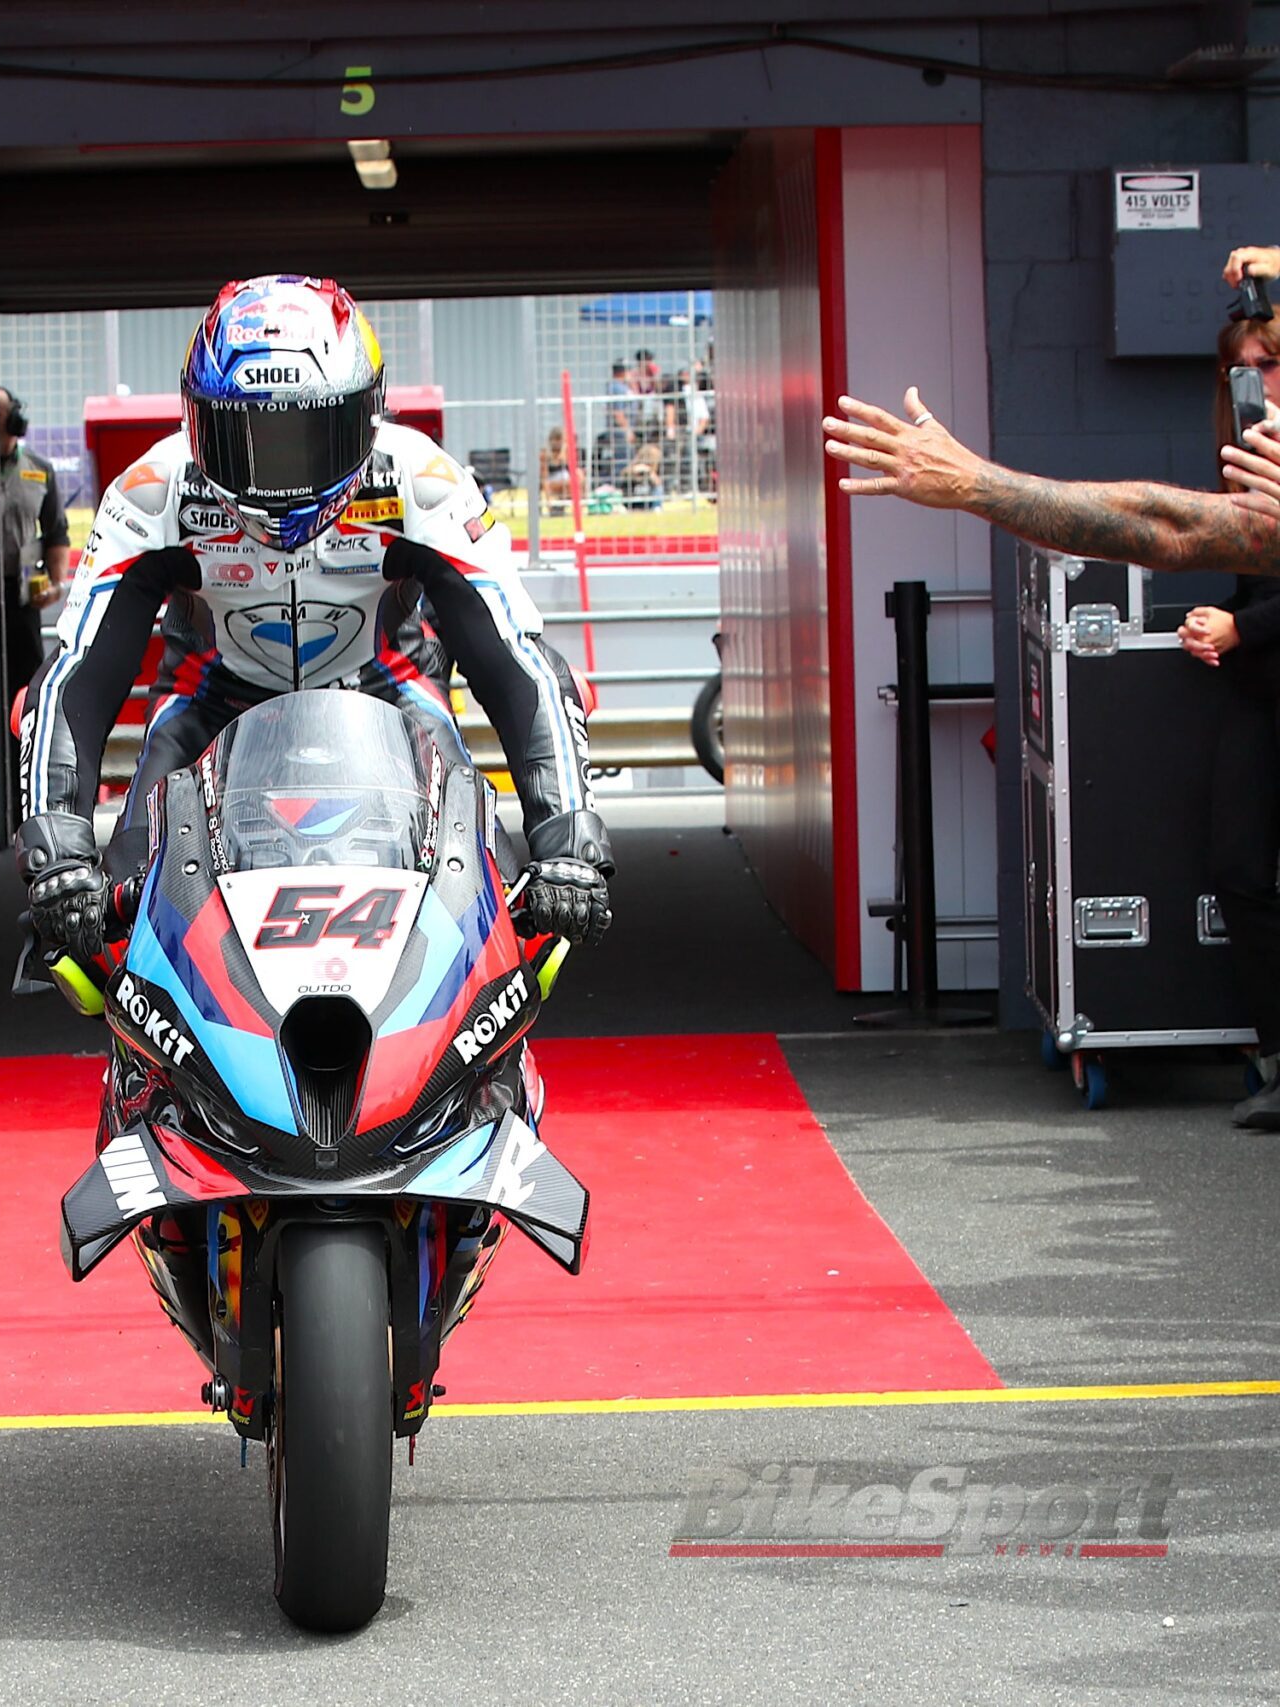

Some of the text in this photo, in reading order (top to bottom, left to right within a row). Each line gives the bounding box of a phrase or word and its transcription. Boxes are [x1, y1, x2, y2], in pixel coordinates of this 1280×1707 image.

[341, 66, 375, 115] 5
[1125, 194, 1191, 208] 415 VOLTS
[244, 367, 300, 385] SHOEI
[211, 395, 345, 412] GIVES YOU WINGS
[253, 884, 407, 950] 54
[298, 984, 352, 993] OUTDO
